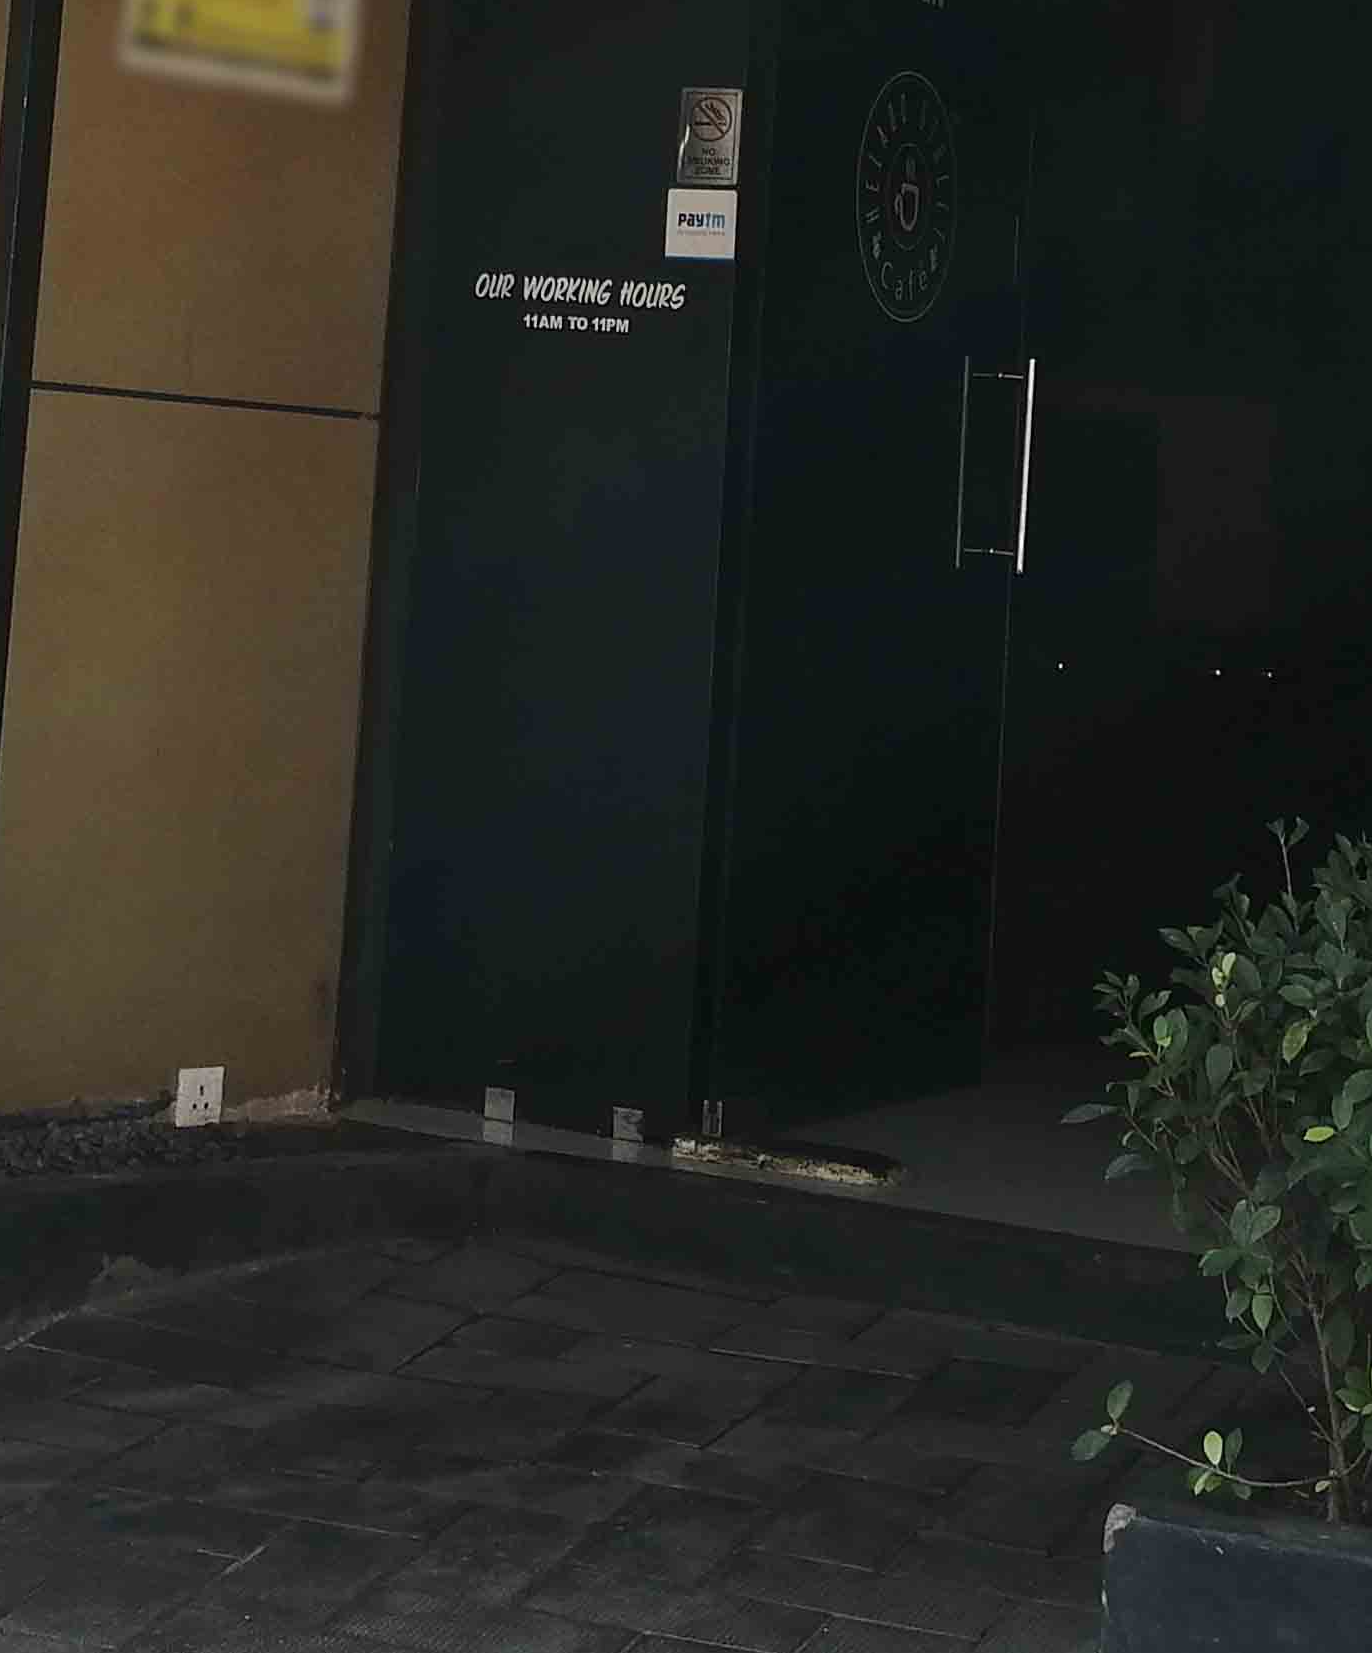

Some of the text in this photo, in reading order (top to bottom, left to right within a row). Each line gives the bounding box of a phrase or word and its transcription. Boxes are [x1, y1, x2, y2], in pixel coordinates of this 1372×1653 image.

[475, 272, 686, 310] OUR WORKING HOURS
[523, 313, 630, 333] 11AM TO 11PM
